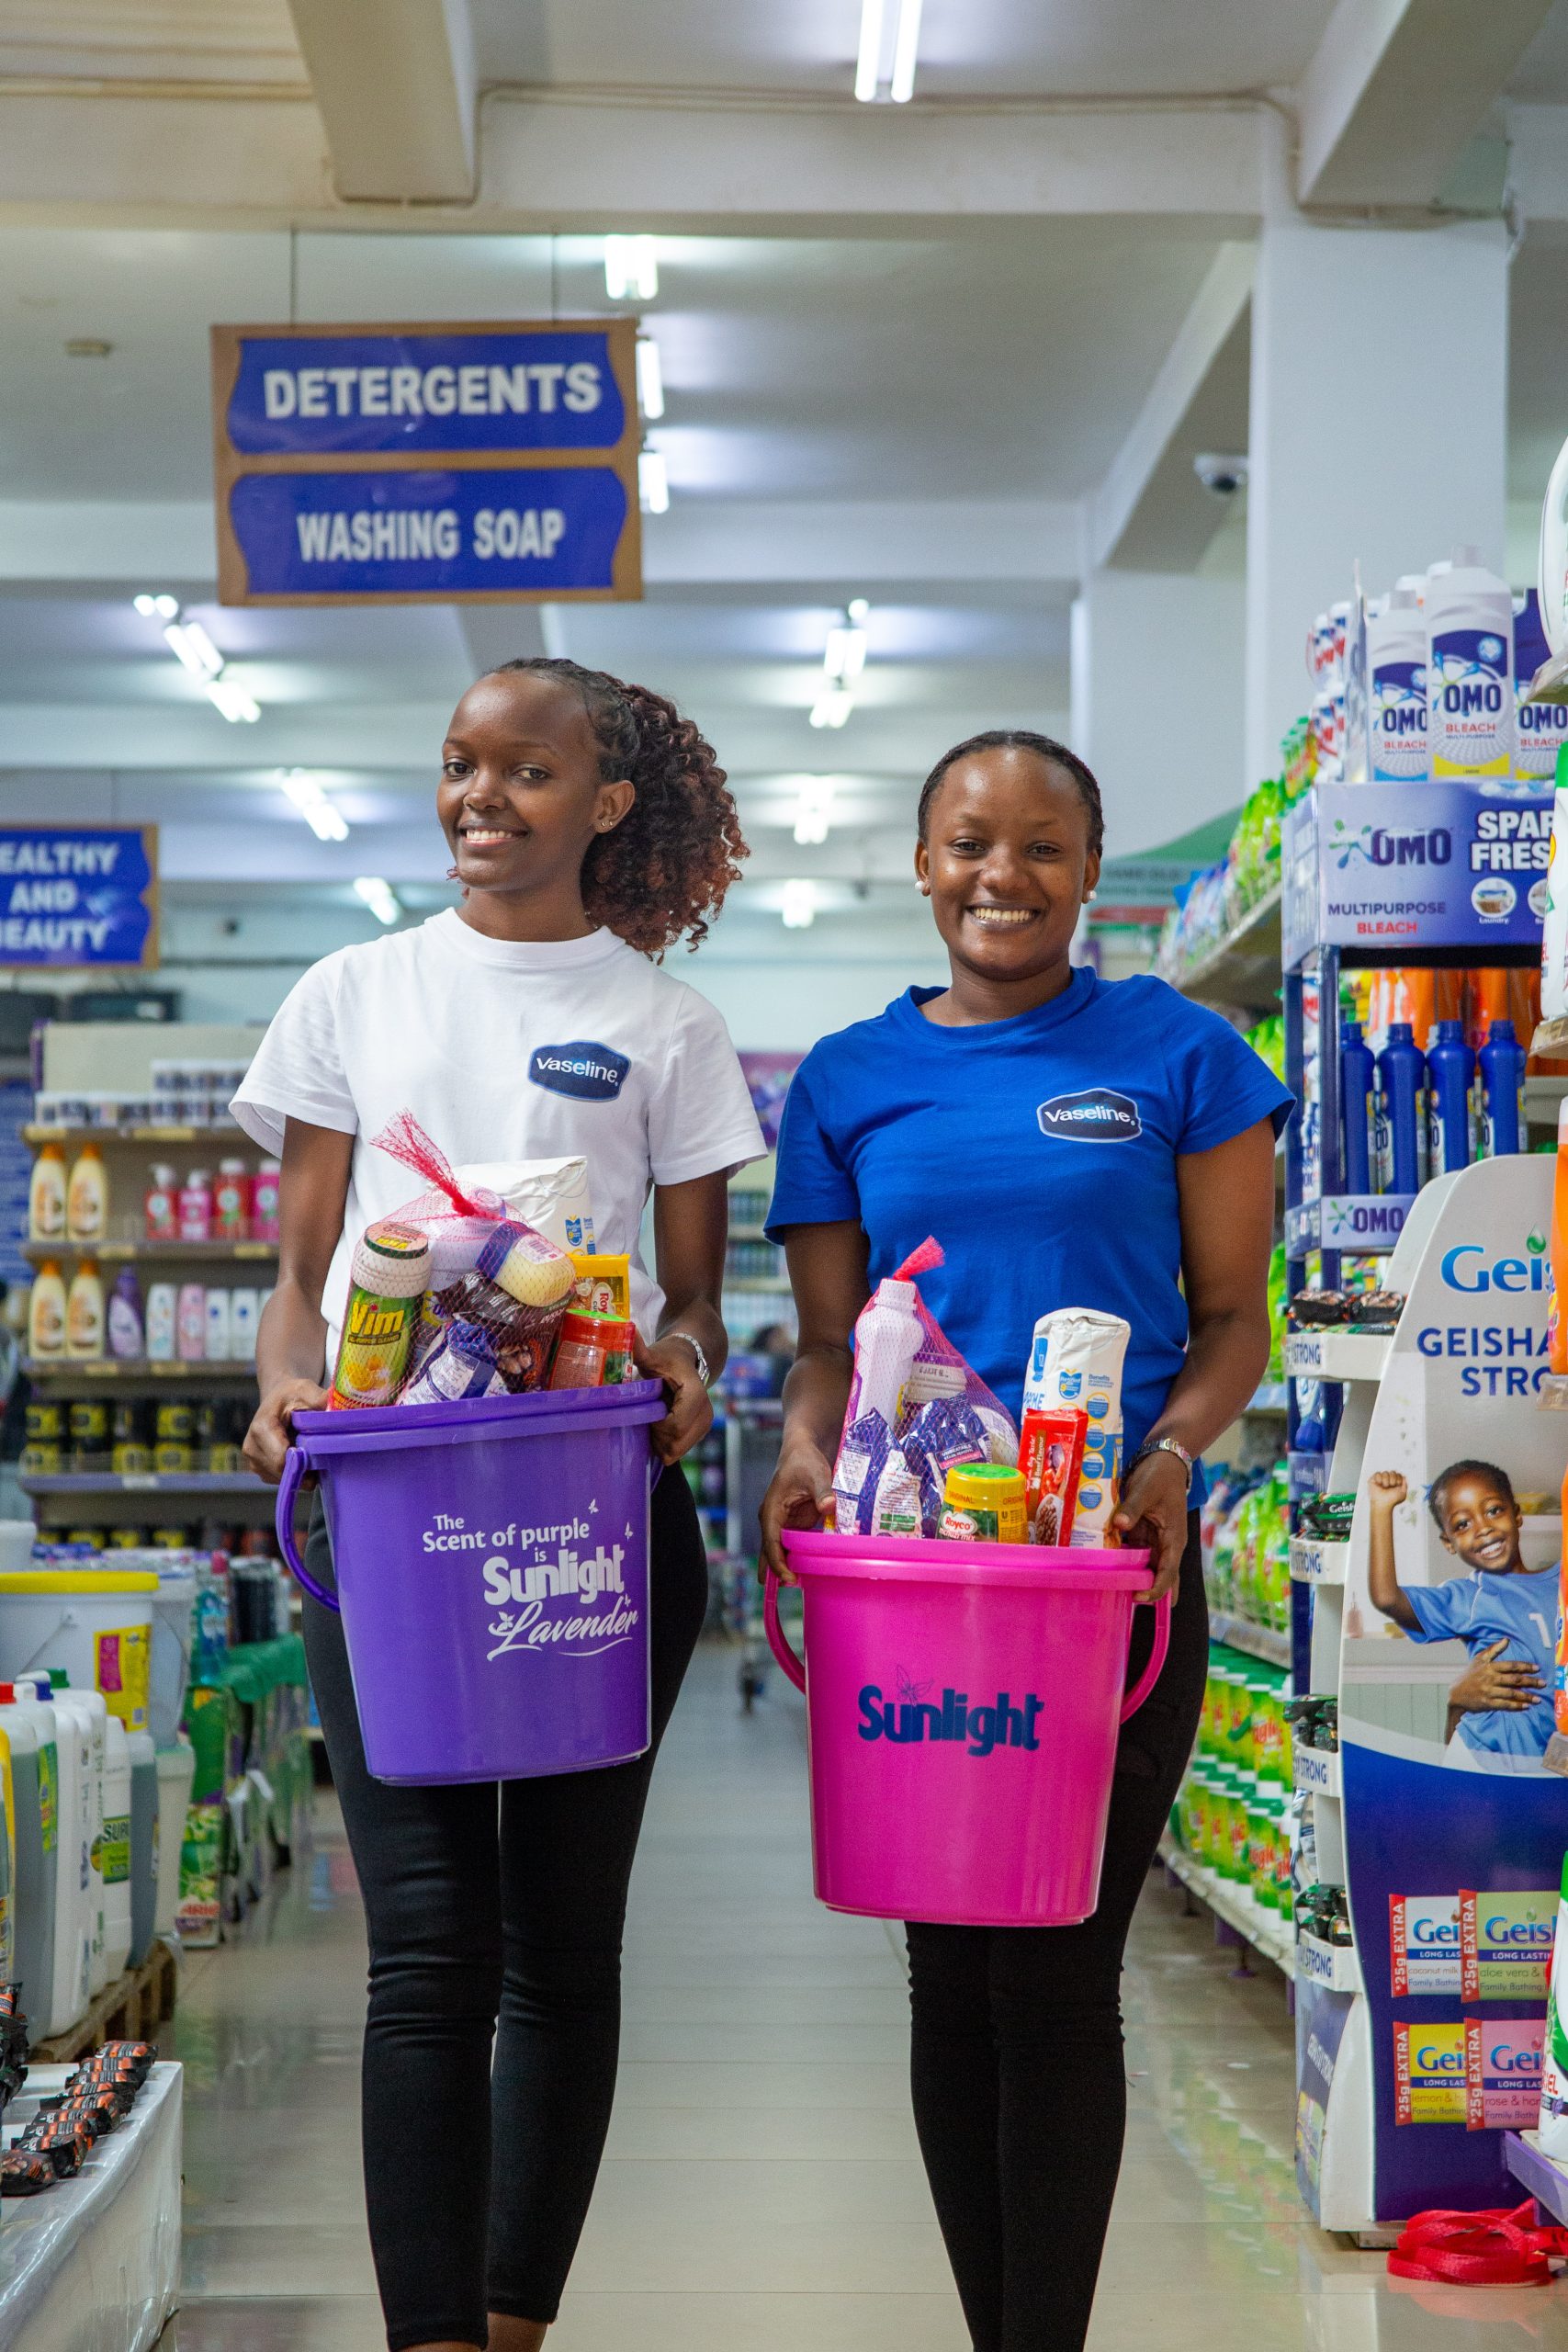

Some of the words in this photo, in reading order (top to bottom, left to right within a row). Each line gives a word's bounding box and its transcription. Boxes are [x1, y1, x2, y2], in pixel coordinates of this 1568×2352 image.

[264, 363, 602, 419] DETERGENTS
[298, 511, 458, 562] WASHING
[474, 508, 566, 560] SOAP
[1443, 684, 1501, 713] OMO
[1446, 723, 1495, 732] BLEACH
[1518, 706, 1567, 729] OMO
[1384, 741, 1426, 749] BLEACH
[1371, 828, 1451, 865] OMO
[9, 879, 77, 912] AND
[1327, 901, 1446, 916] MULTIPURPOSE
[0, 919, 109, 951] EAUTY
[1357, 922, 1417, 934] BLEACH
[1352, 1207, 1404, 1233] OMO
[1440, 1244, 1551, 1294] Gei
[351, 1301, 404, 1336] Vim
[423, 1531, 486, 1553] Scent
[491, 1523, 516, 1547] of
[521, 1517, 590, 1551] purple
[433, 1514, 465, 1532] The
[945, 1516, 971, 1531] Royco
[535, 1547, 547, 1563] is
[482, 1544, 626, 1606] Sunlight
[487, 1595, 638, 1661] Lavender
[1529, 1612, 1551, 1649] 1
[857, 1685, 1044, 1758] Sunlight
[1299, 1757, 1327, 1784] STRONG
[1393, 1904, 1405, 1953] EXTRA
[1462, 1900, 1477, 1954] EXTRA
[1304, 1948, 1331, 1978] STRONG
[1442, 1966, 1458, 1974] milk
[1480, 1967, 1503, 1977] aloe
[1506, 1969, 1529, 1977] vera
[1531, 1967, 1540, 1977] &
[1409, 1978, 1432, 1987] Family
[1480, 1982, 1506, 1992] Family
[1509, 1982, 1542, 1992] Bathing
[1397, 2031, 1409, 2081] EXTRA
[1416, 2045, 1465, 2071] Gei
[1468, 2028, 1481, 2082] EXTRA
[1490, 2044, 1542, 2072] Gei
[1412, 2093, 1442, 2102] lemon
[1444, 2092, 1452, 2103] &
[1497, 2080, 1523, 2088] LONG
[1413, 2107, 1436, 2116] Family
[1485, 2098, 1507, 2106] rose
[1511, 2095, 1519, 2106] &
[1485, 2111, 1512, 2120] Family
